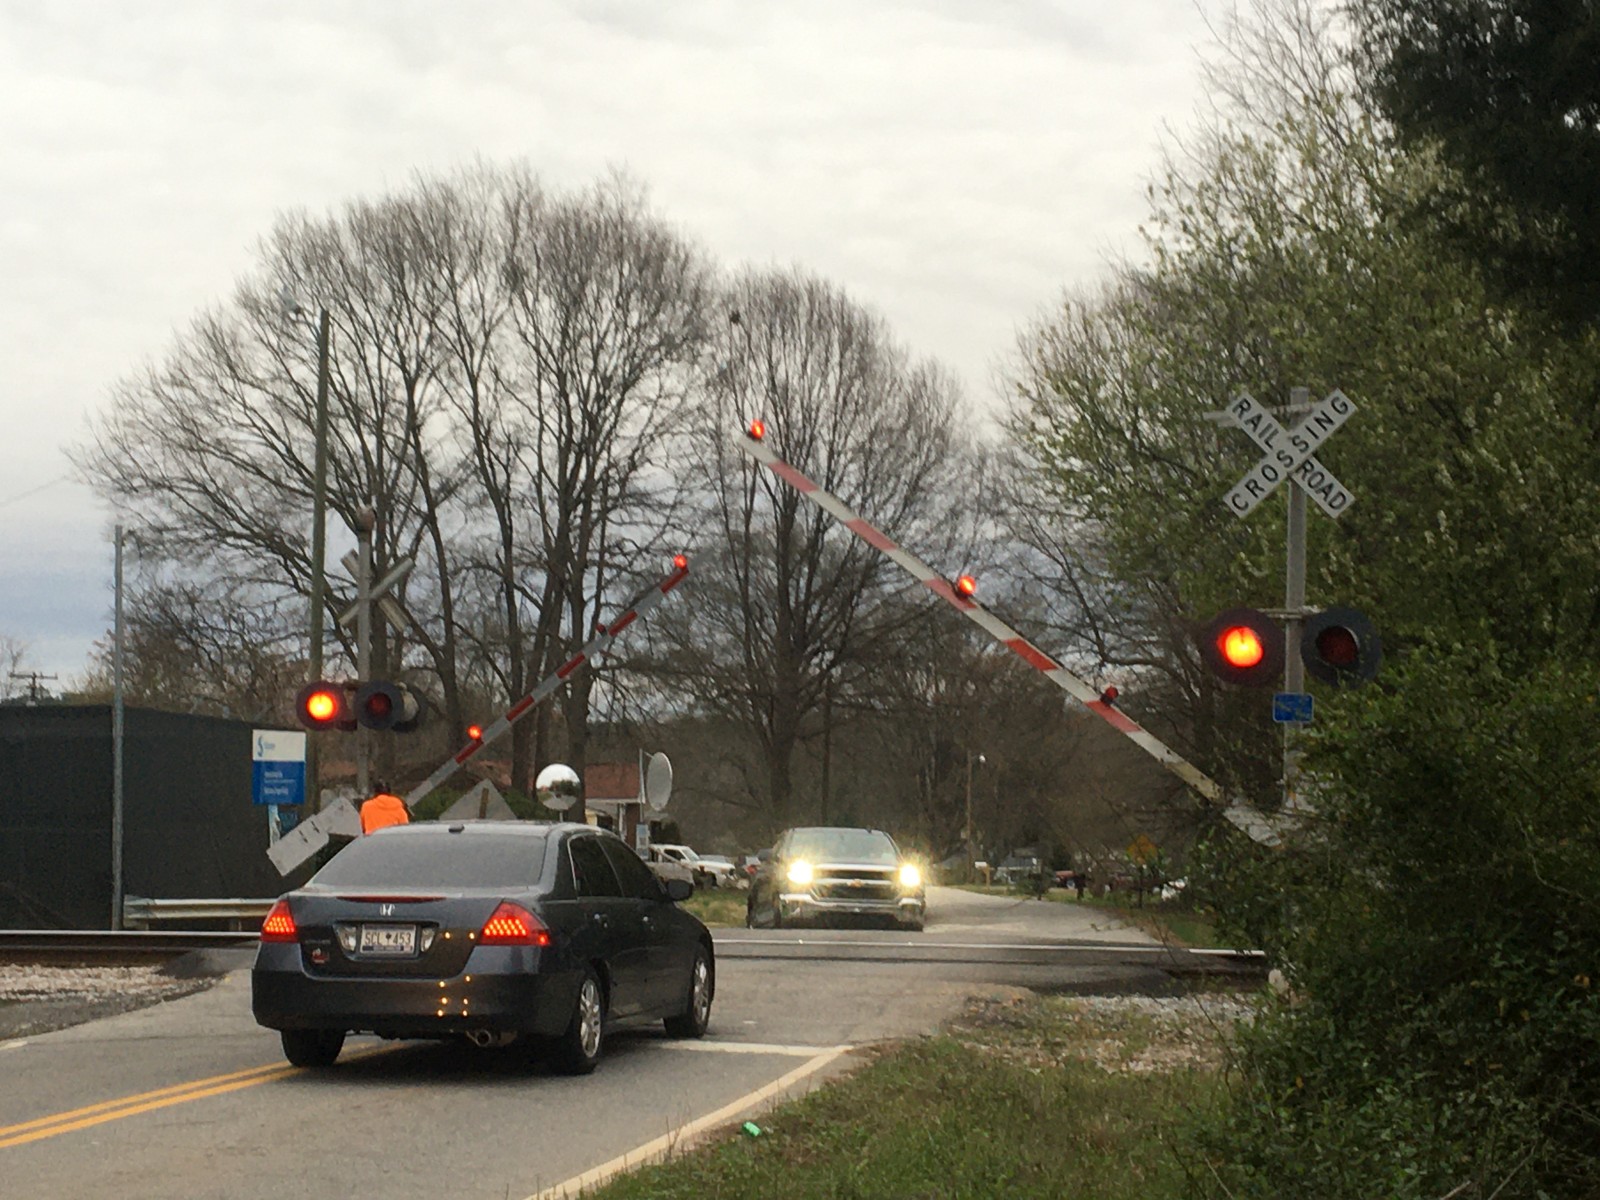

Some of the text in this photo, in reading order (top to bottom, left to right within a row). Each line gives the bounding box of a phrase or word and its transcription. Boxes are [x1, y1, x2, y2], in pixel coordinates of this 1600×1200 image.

[1231, 396, 1349, 511] CROSSING
[1232, 398, 1346, 510] RAIL ROAD
[393, 931, 412, 945] 453
